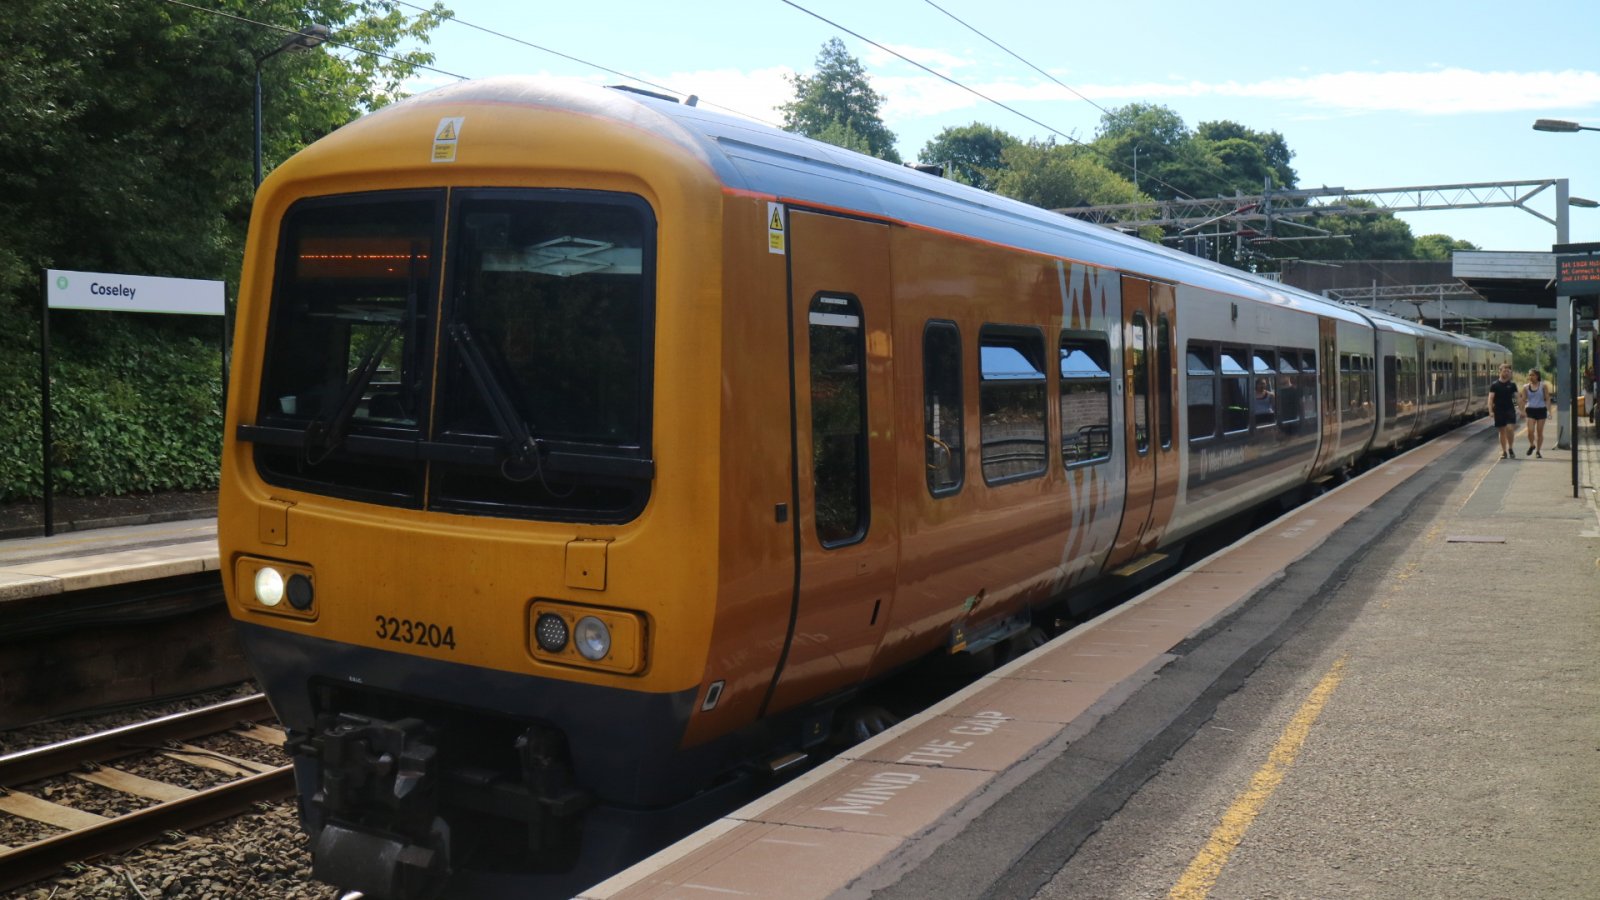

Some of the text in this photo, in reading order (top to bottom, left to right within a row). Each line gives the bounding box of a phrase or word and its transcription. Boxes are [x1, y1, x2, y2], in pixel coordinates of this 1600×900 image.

[90, 282, 136, 300] Coseley
[375, 614, 456, 650] 323204
[816, 711, 1010, 815] MIND THE GAP
